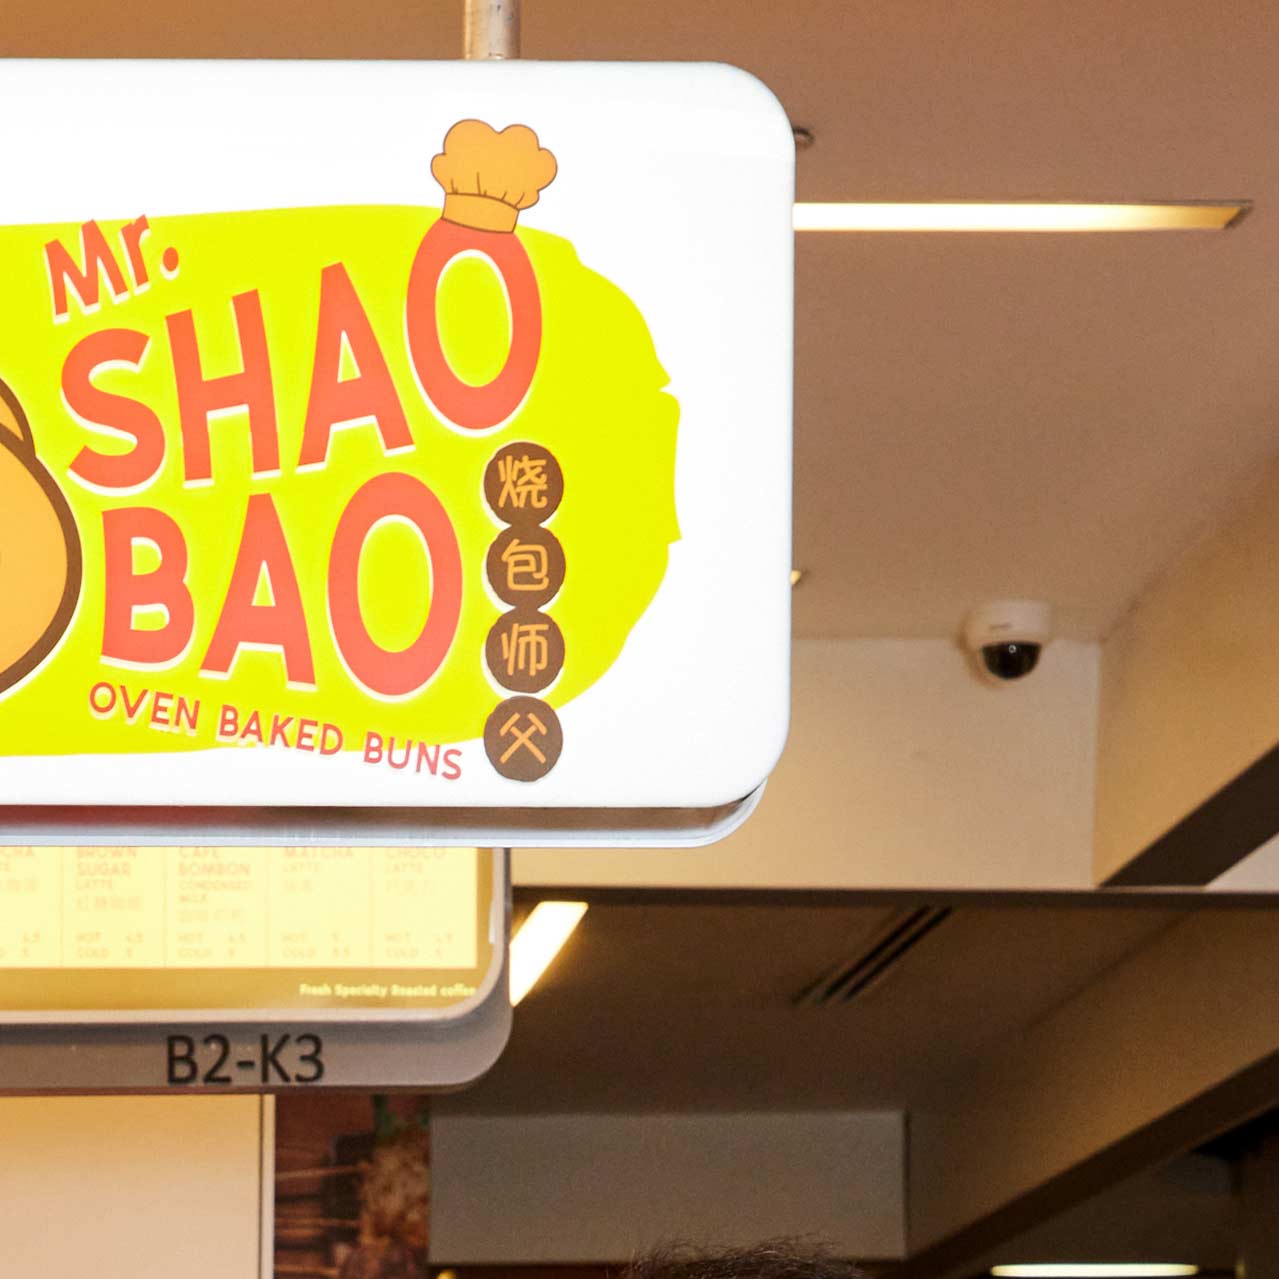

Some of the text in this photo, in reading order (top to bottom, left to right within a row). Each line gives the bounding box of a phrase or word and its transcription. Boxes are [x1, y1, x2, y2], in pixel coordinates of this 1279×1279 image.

[44, 213, 180, 318] Mr.
[60, 214, 543, 490] SHAO
[100, 471, 464, 698] BAO
[89, 681, 463, 782] OVEN BAKED BUNS
[77, 861, 132, 876] SUGAR
[165, 1033, 326, 1085] B2-K3
